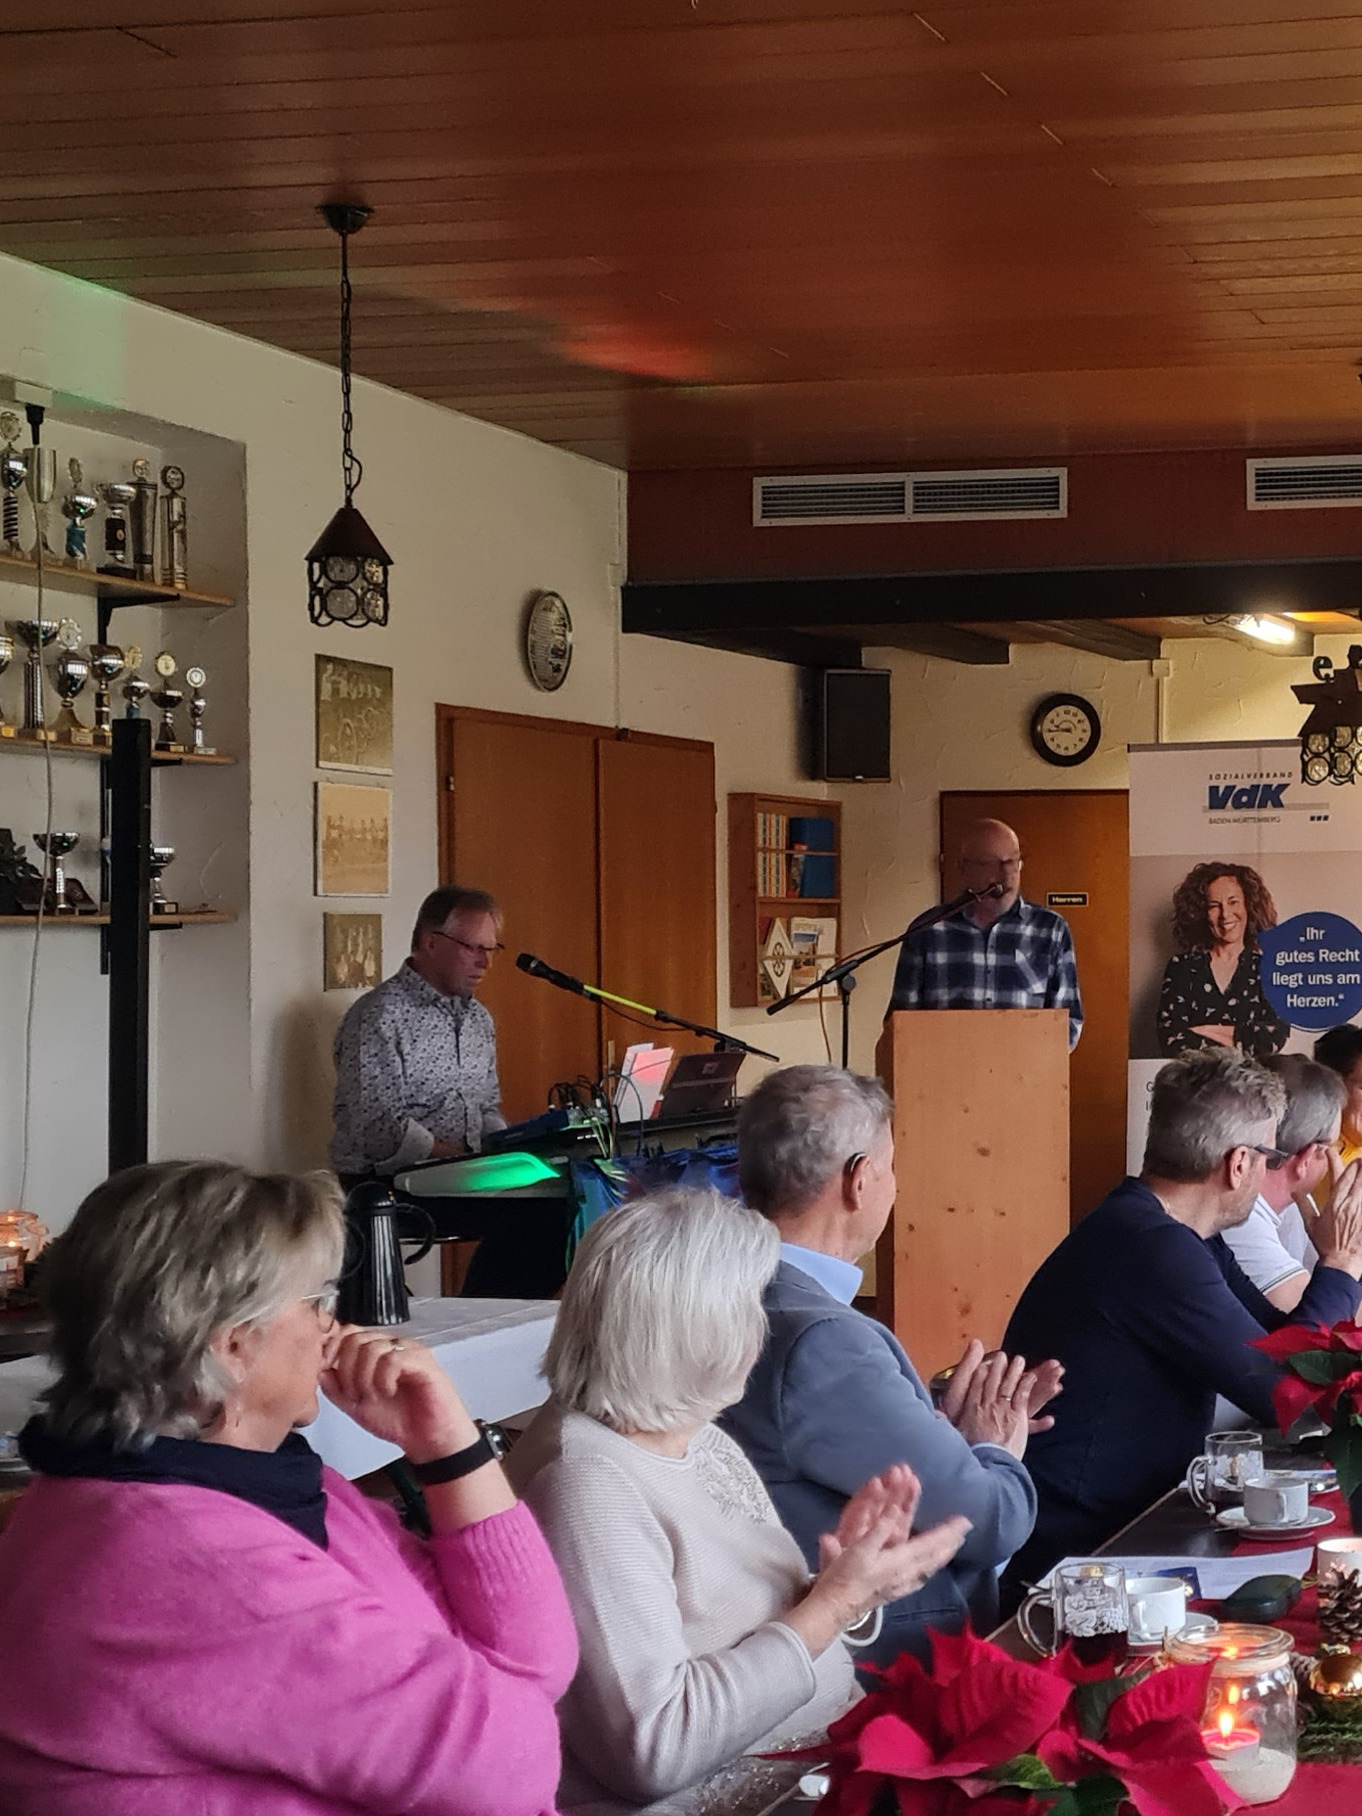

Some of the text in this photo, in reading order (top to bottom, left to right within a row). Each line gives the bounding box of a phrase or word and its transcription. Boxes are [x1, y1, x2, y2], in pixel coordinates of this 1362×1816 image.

[1209, 772, 1293, 780] SOZIALVERBAND
[1208, 783, 1290, 810] VdK
[1275, 948, 1360, 966] gutes Recht
[1272, 971, 1360, 988] liegt uns am
